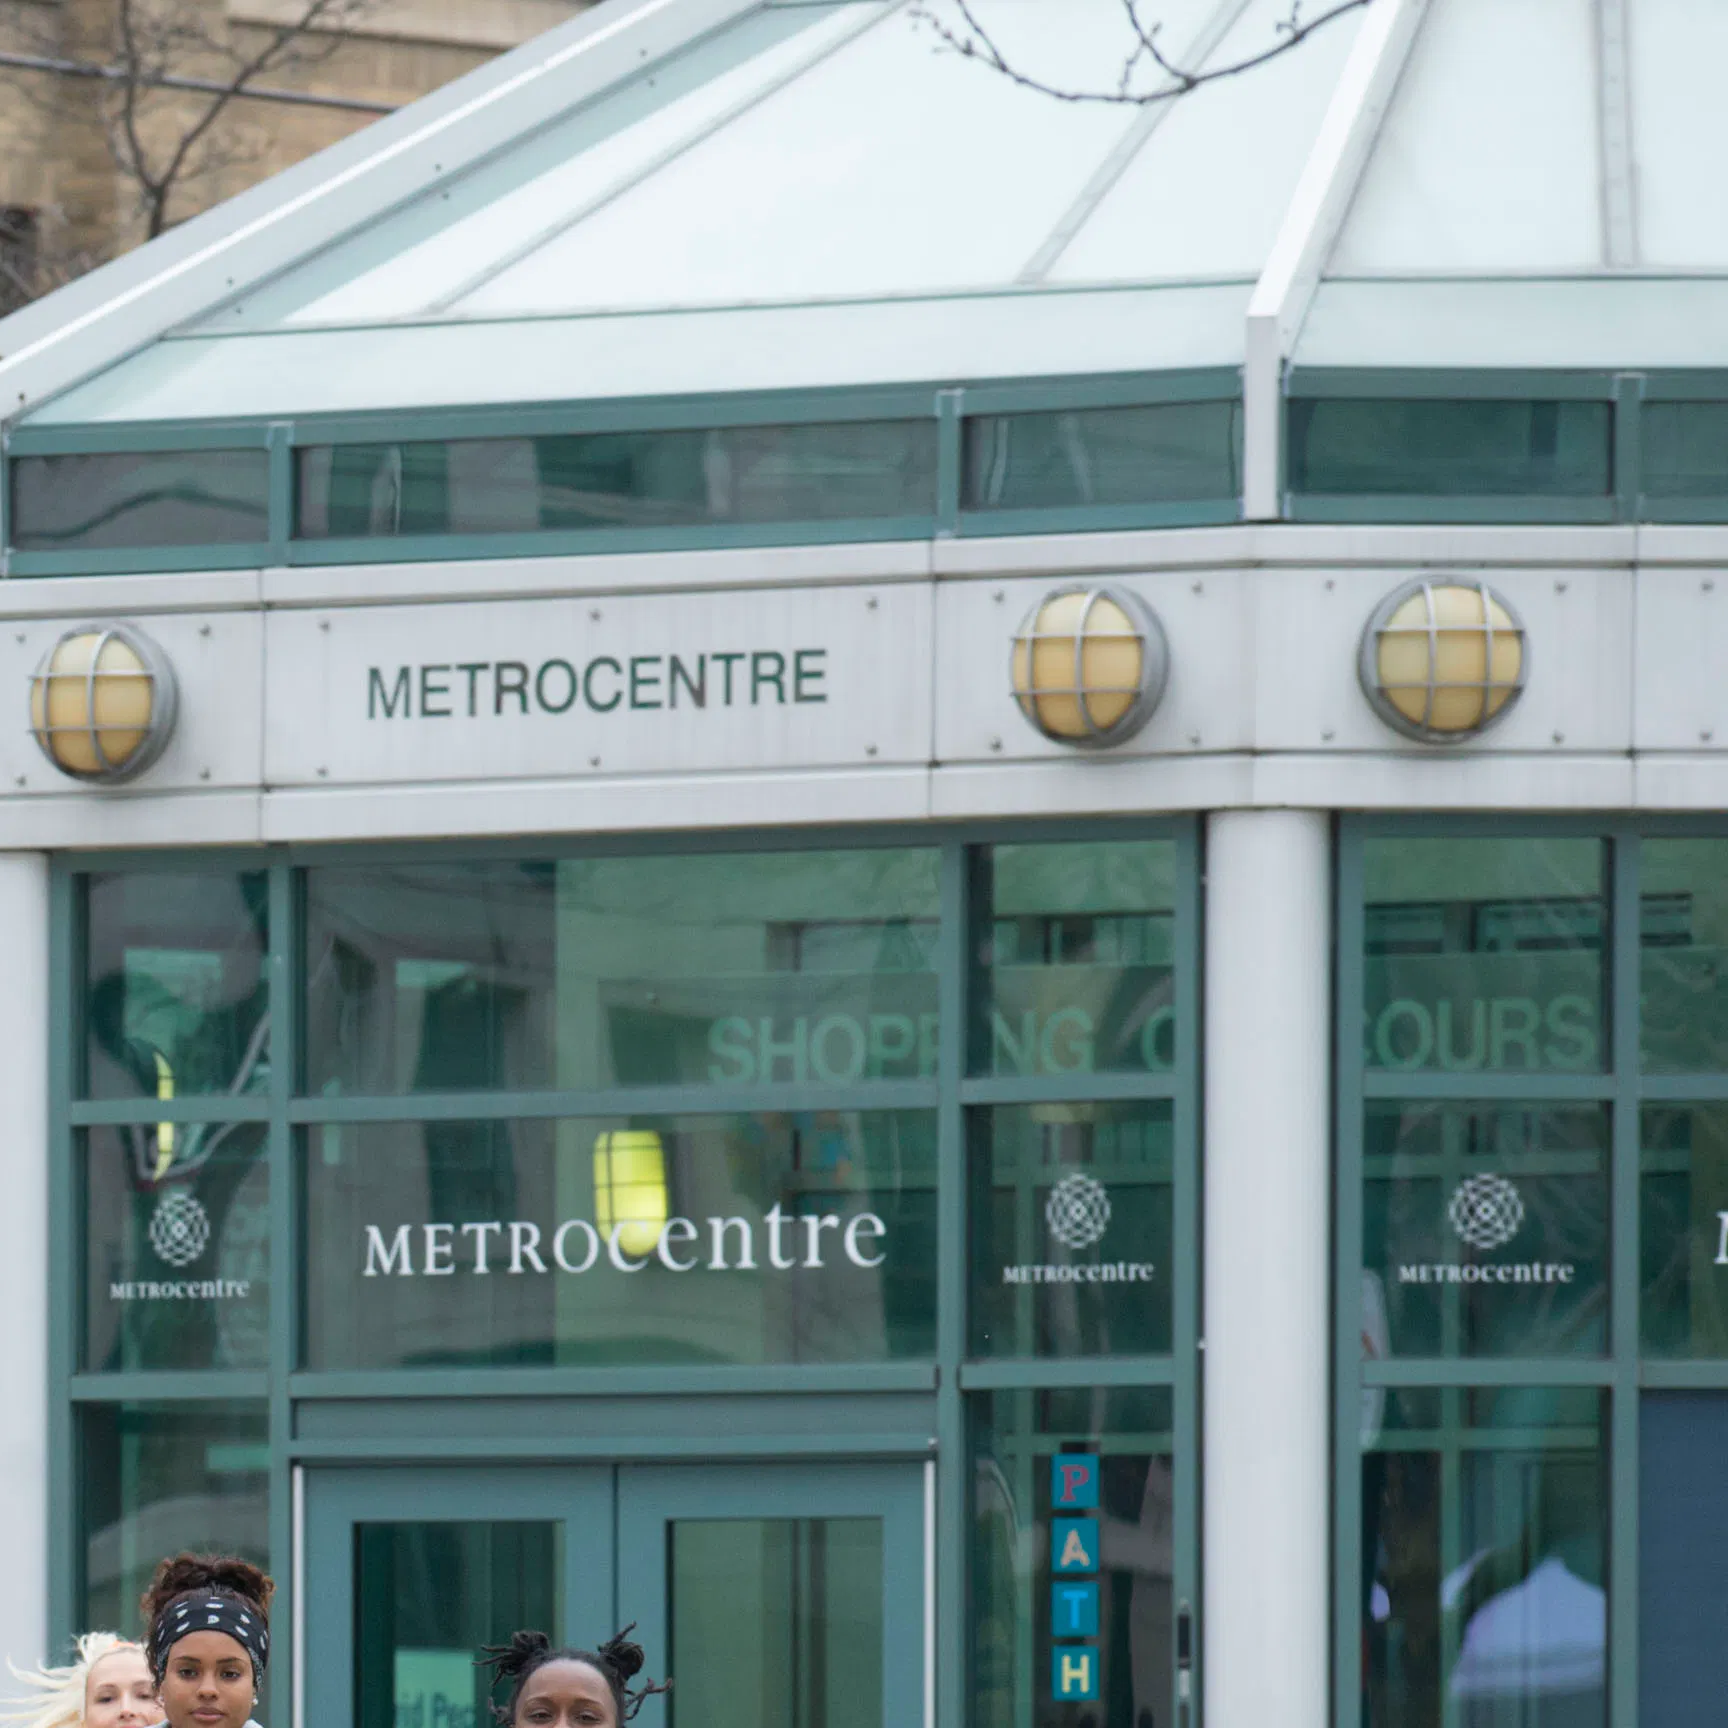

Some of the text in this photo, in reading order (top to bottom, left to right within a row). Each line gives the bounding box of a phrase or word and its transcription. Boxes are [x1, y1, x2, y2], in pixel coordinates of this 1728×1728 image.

[367, 648, 828, 720] METROCENTRE
[362, 1201, 887, 1277] METROcentre
[1059, 1464, 1092, 1695] PATH
